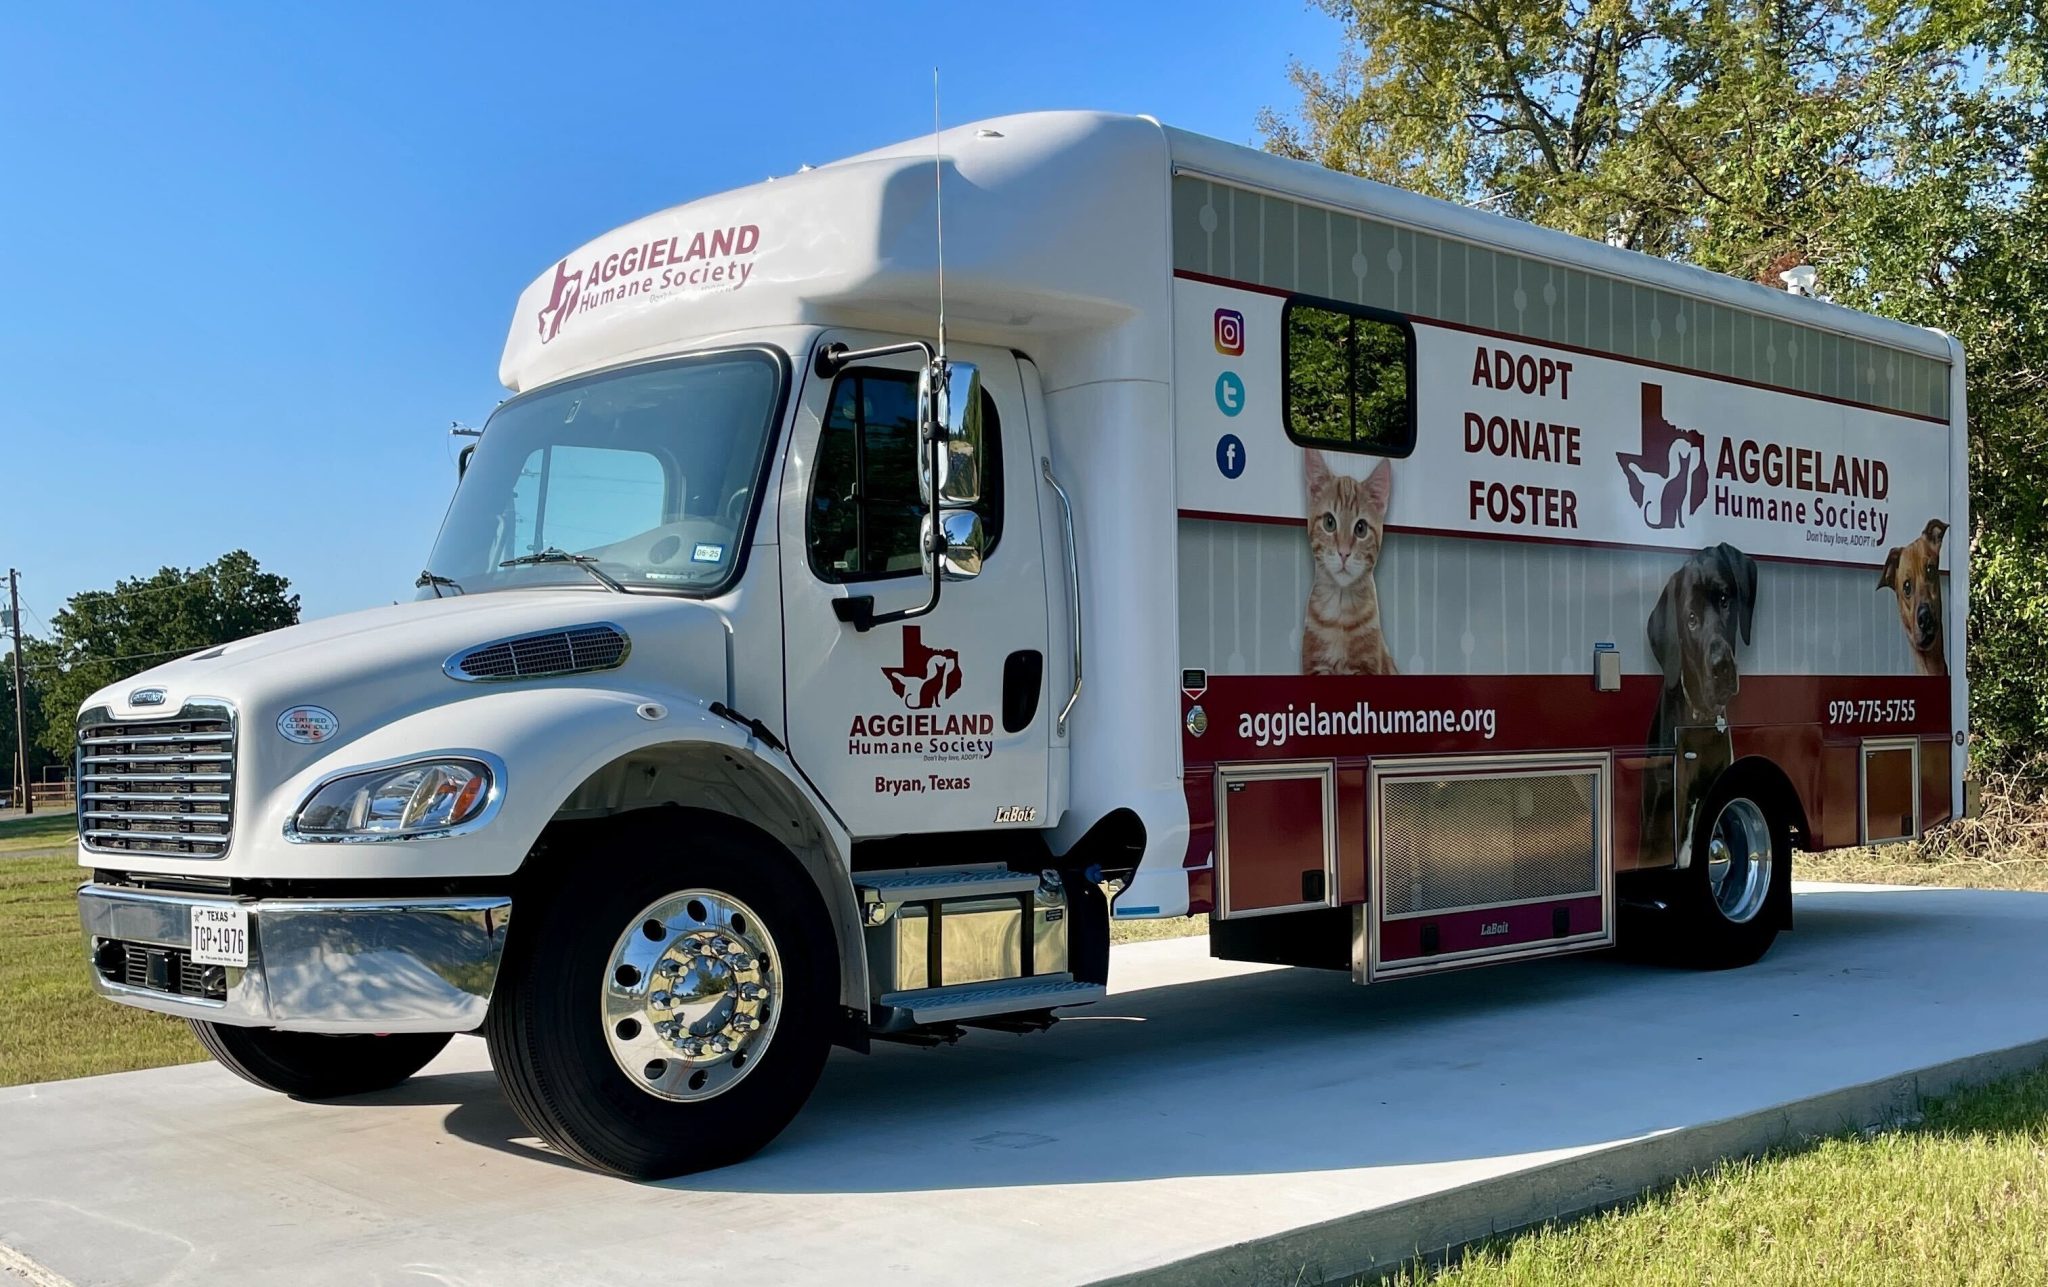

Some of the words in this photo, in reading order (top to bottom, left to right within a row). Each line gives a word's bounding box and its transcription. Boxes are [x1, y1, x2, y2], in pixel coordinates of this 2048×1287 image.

[585, 224, 760, 291] AGGIELAND
[579, 277, 653, 314] Humane
[659, 261, 753, 291] Society
[1472, 346, 1573, 400] ADOPT
[1464, 412, 1581, 466] DONATE
[1715, 436, 1889, 501] AGGIELAND
[1469, 480, 1578, 529] FOSTER
[1714, 485, 1806, 525] Humane
[1814, 497, 1889, 547] Society
[1806, 530, 1823, 543] Don't
[1823, 532, 1835, 546] buy
[1849, 534, 1871, 547] ADOPT
[849, 714, 994, 737] AGGIELAND
[1238, 702, 1496, 746] aggielandhumane.org
[1829, 699, 1916, 724] 979-775-5755
[848, 739, 923, 755] Humane
[929, 737, 993, 759] Society
[875, 776, 926, 796] Bryan,
[928, 775, 971, 790] Texas
[994, 806, 1037, 824] LaBoit
[207, 910, 229, 922] TEXAS
[1480, 920, 1509, 936] LaBoit
